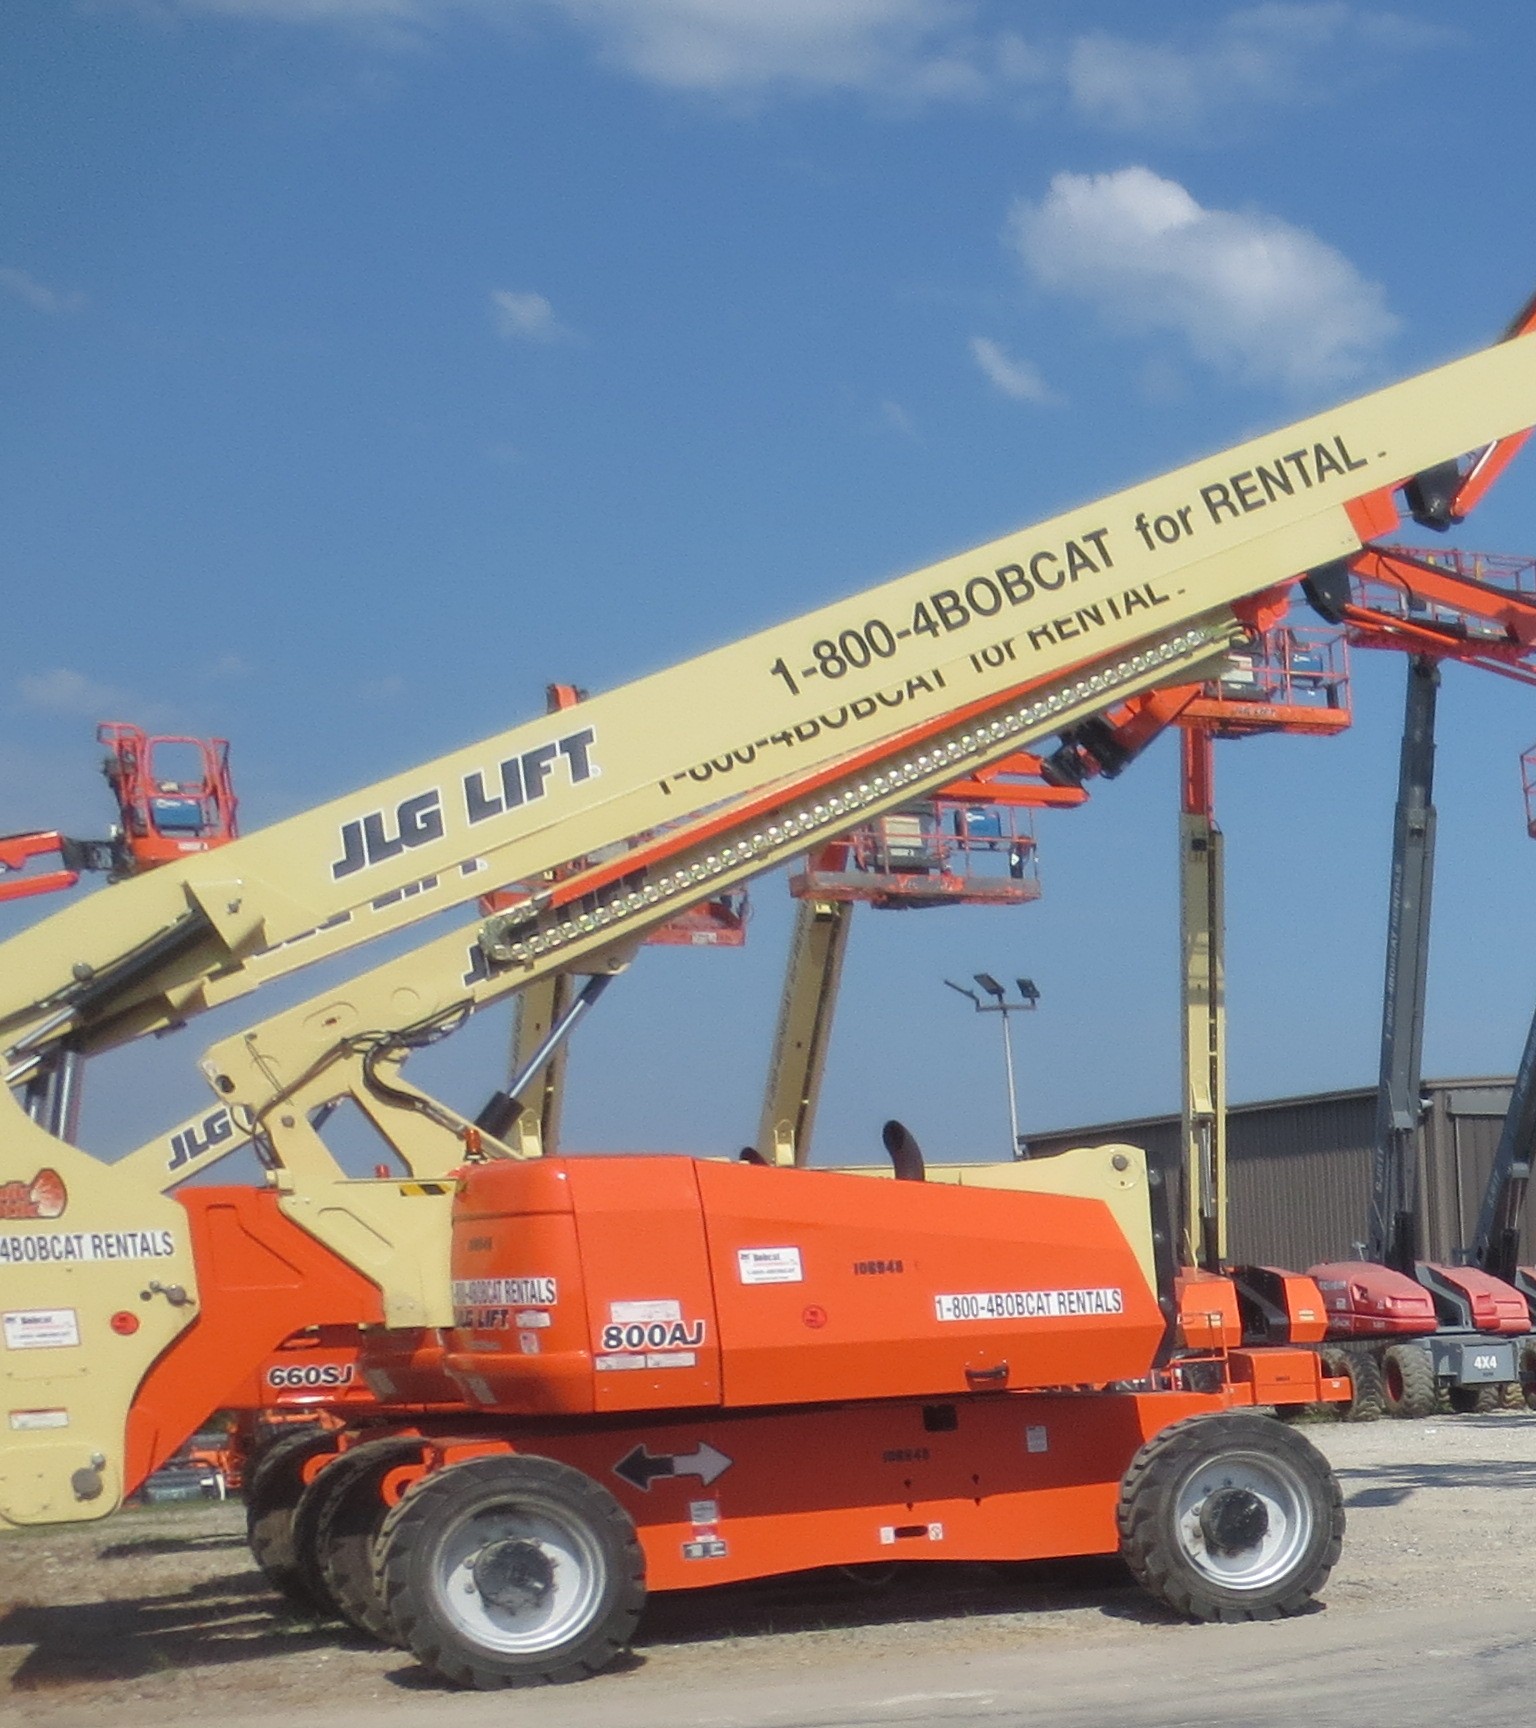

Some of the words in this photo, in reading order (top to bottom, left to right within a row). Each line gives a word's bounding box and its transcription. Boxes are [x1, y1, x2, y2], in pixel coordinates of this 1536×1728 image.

[769, 528, 1114, 695] 1-800-4BOBCAT
[1135, 505, 1194, 550] for
[1200, 435, 1368, 524] RENTAL
[332, 788, 445, 880] JLG
[463, 726, 595, 826] LIFT
[168, 1107, 234, 1171] JLG
[92, 1231, 174, 1258] RENTALS
[504, 1279, 555, 1304] RENTALS
[936, 1293, 1051, 1319] 1-800-4BOBCAT
[1057, 1290, 1121, 1313] RENTALS
[603, 1321, 705, 1349] 800AJ
[268, 1364, 354, 1387] 660SJ
[1473, 1355, 1497, 1370] 4X4
